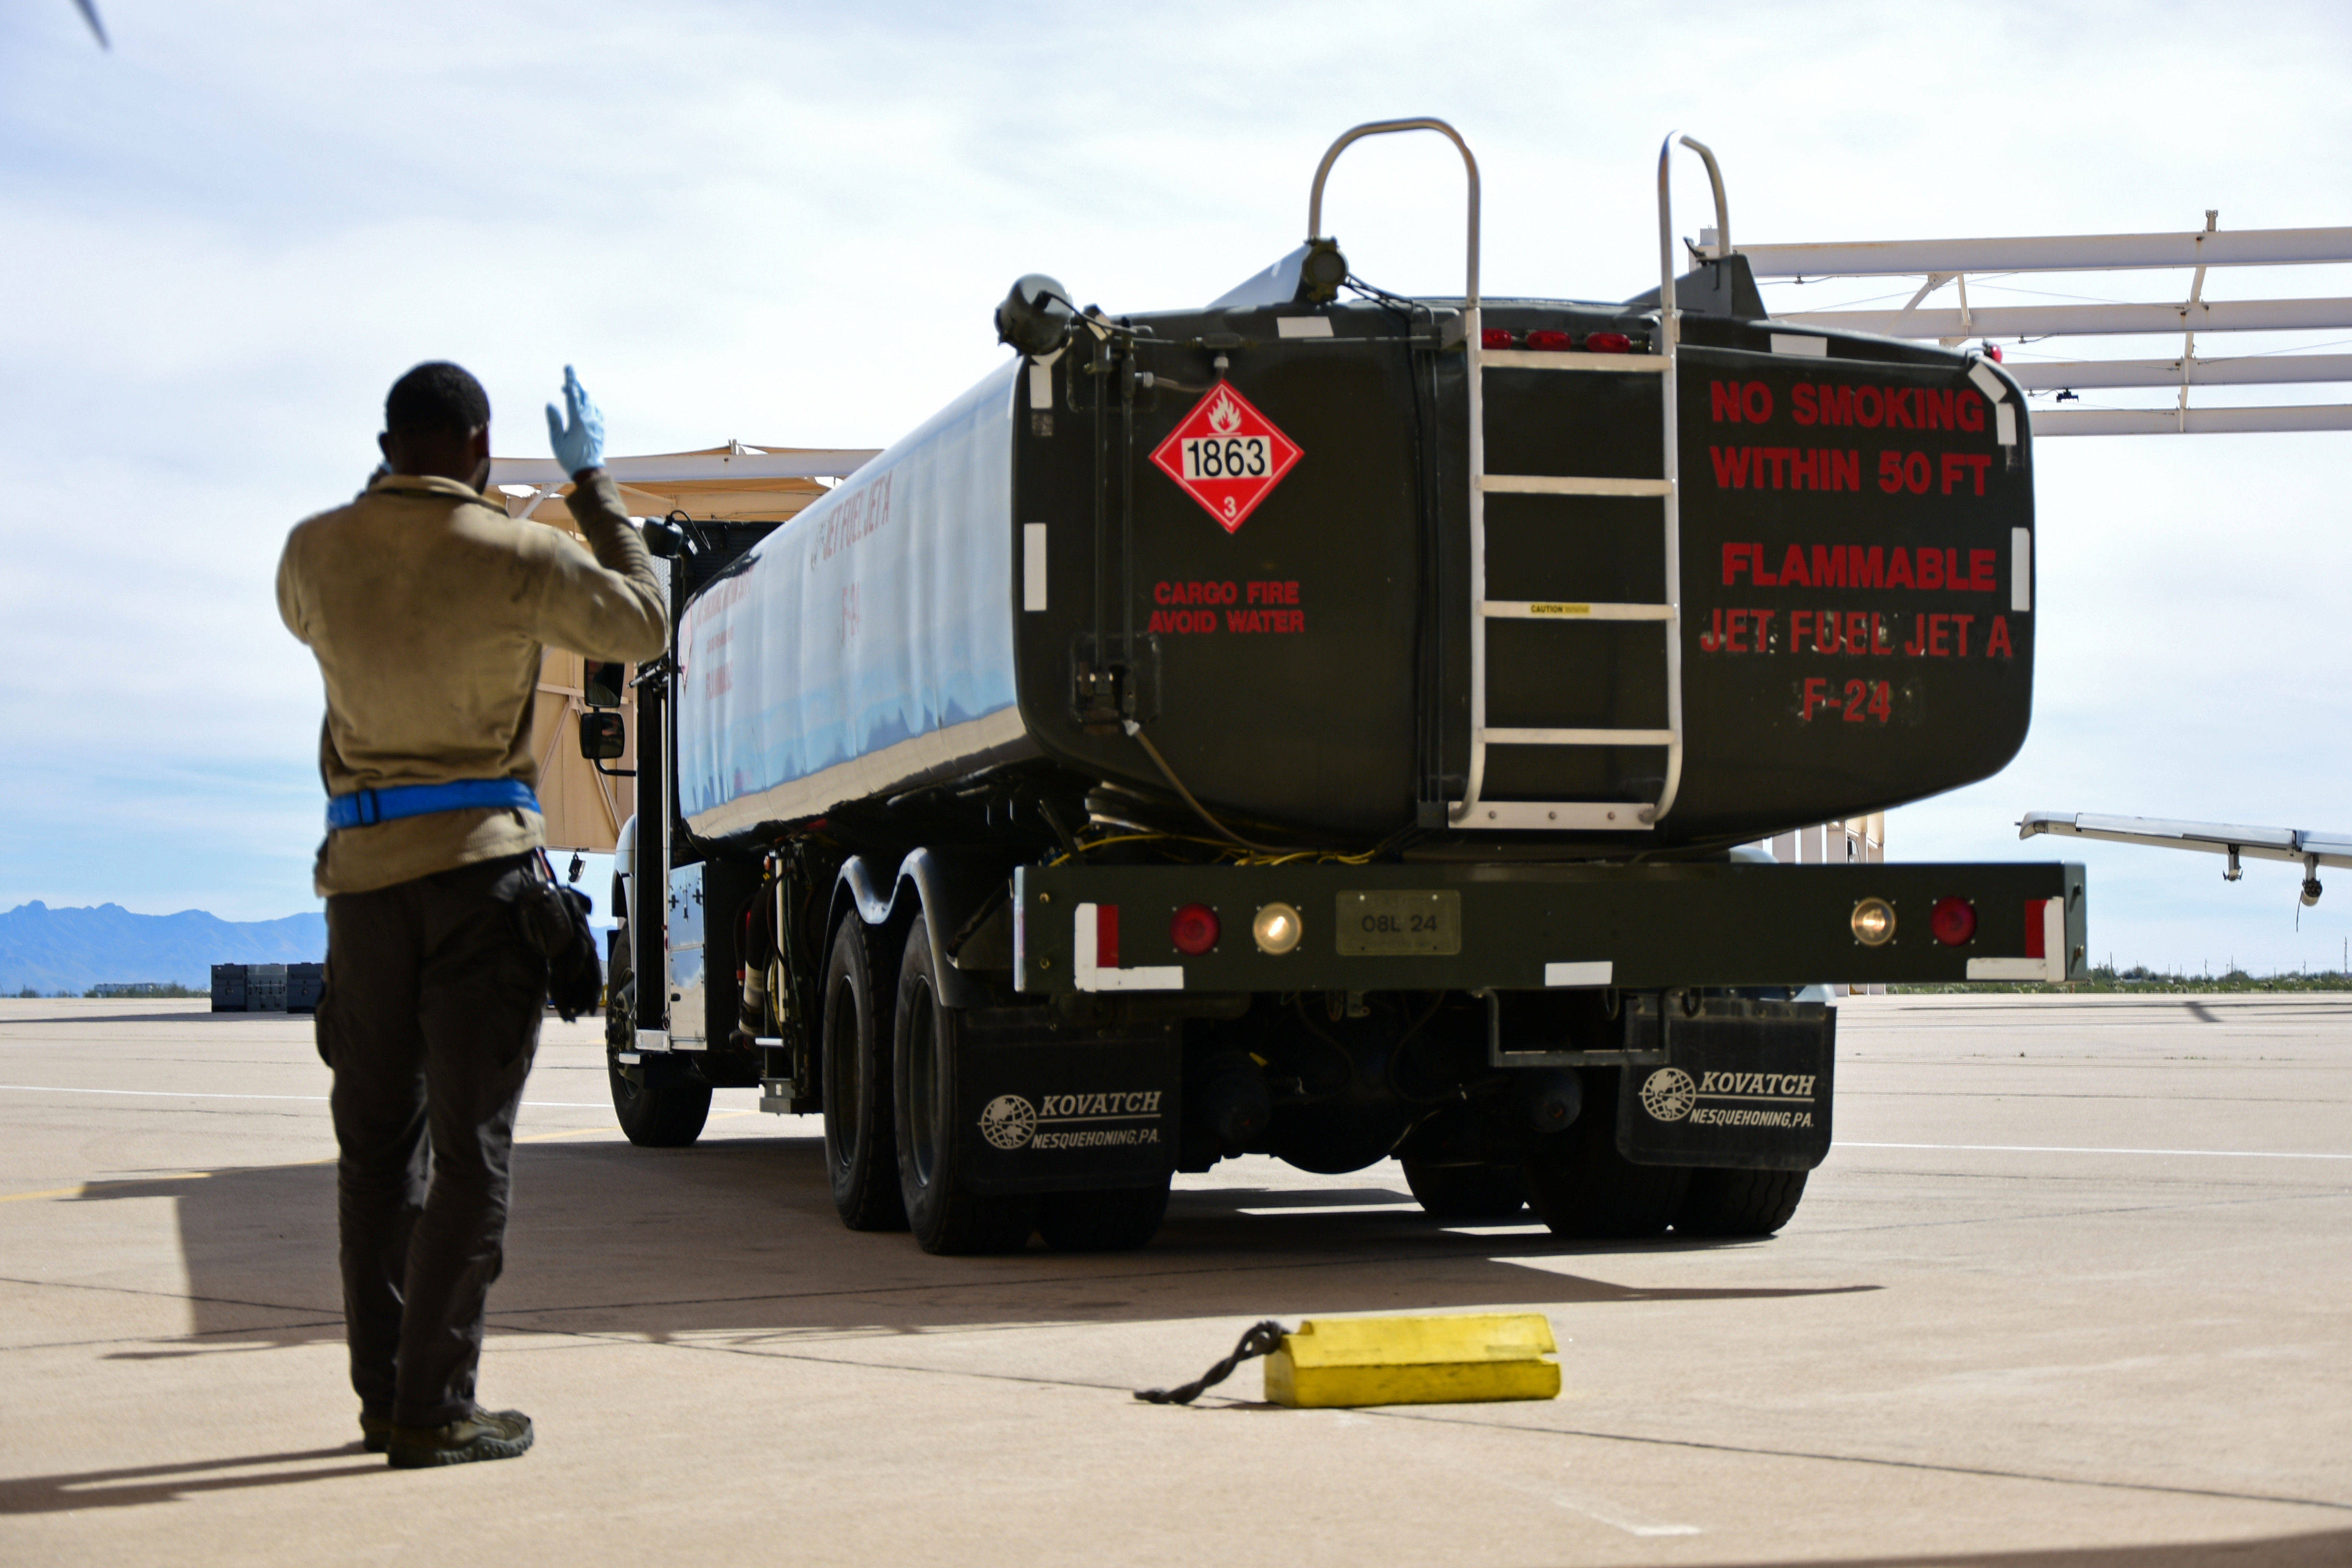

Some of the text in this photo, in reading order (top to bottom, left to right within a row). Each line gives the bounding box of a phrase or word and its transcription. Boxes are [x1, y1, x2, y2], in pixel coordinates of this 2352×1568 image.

[1711, 381, 1985, 432] NO SMOKING
[1187, 439, 1265, 476] 1863
[1710, 445, 1992, 496] WITHIN 50 FT
[1224, 496, 1236, 518] 3
[1722, 542, 1997, 591] FLAMMABLE
[1154, 581, 1300, 606] CARGO FIRE
[1148, 610, 1305, 634] AVOID WATER
[1701, 609, 2012, 658] JET FUEL JET A
[1803, 678, 1891, 722] F-24
[1411, 914, 1437, 932] 24
[1698, 1071, 1816, 1096] KOVATCH
[1039, 1091, 1161, 1116] KOVATCH
